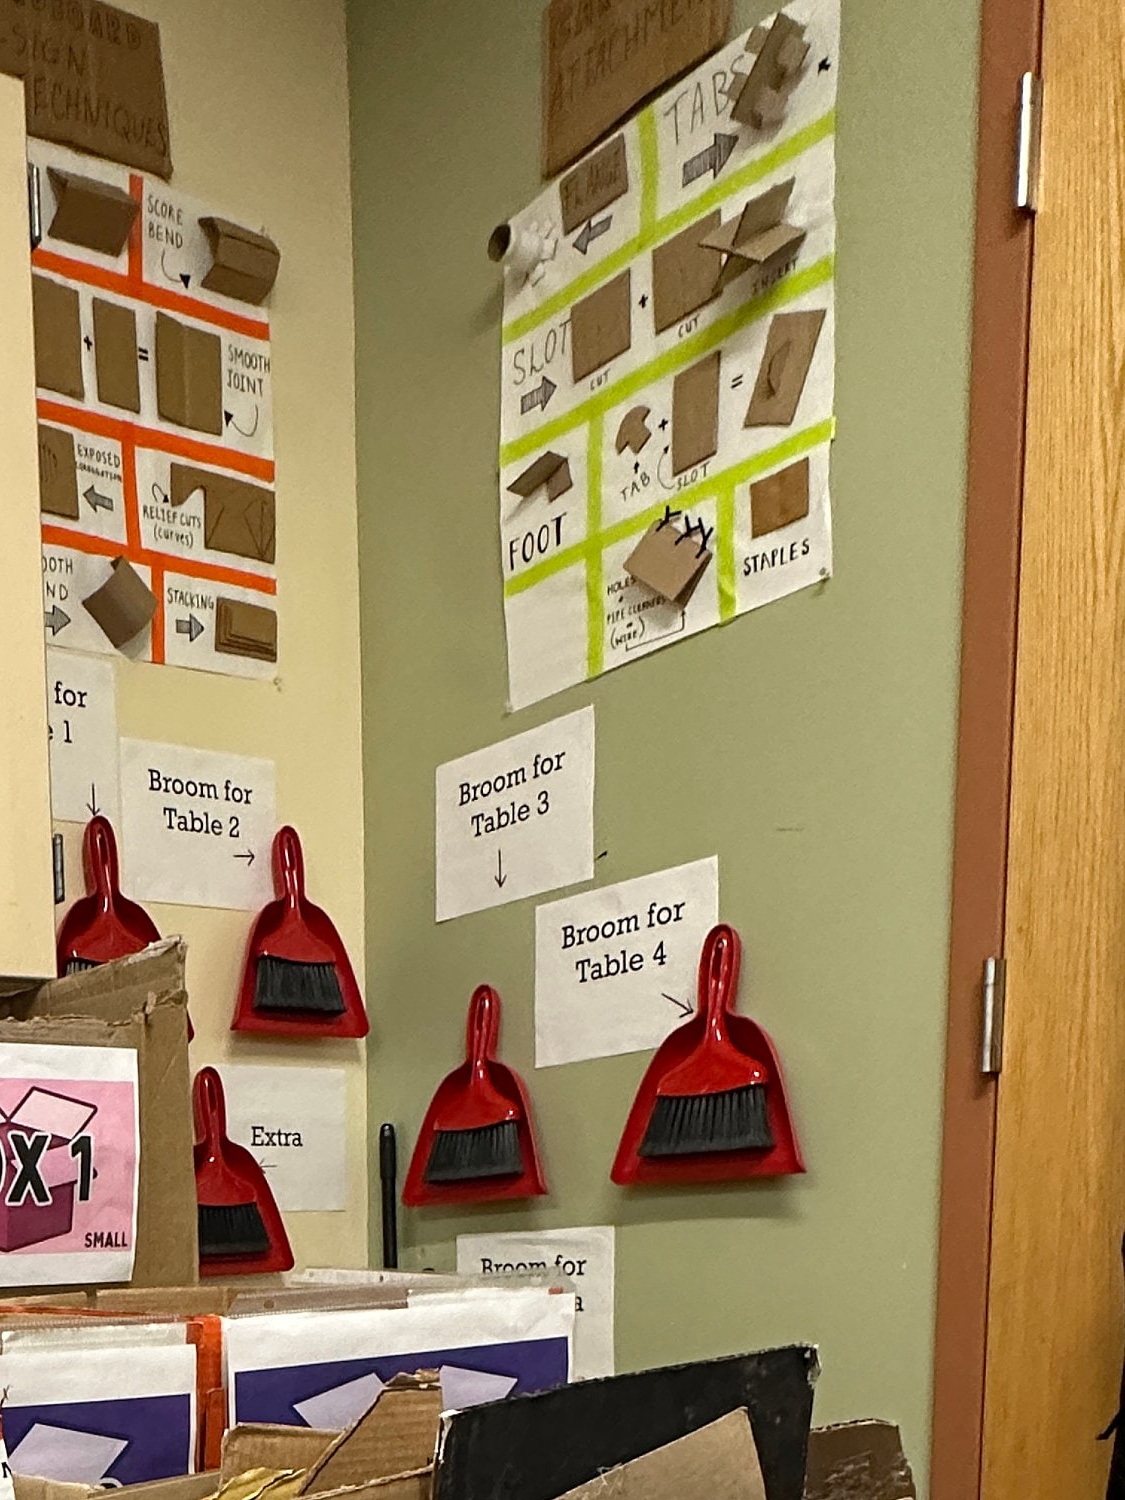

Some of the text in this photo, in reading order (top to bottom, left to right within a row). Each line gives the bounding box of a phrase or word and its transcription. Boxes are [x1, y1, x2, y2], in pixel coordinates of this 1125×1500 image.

[147, 194, 183, 227] SCORE
[148, 223, 183, 250] BEND
[677, 314, 700, 338] CUT
[228, 344, 271, 373] SMOOTH
[513, 319, 572, 386] SLOT
[227, 372, 264, 397] JOINT
[590, 369, 611, 391] CUT
[77, 444, 120, 468] EXPOSED
[619, 471, 650, 502] TAB
[675, 462, 710, 491] SLOT
[142, 505, 201, 528] RELIEF CUTS
[509, 512, 568, 571] FOOT
[743, 539, 811, 576] STAPLES
[167, 587, 214, 611] STACKING
[54, 681, 88, 708] for
[63, 720, 73, 744] 1
[148, 768, 253, 805] Broom for
[458, 751, 566, 807] Broom for
[163, 807, 240, 838] Table 2
[470, 790, 550, 837] Table 3
[561, 901, 686, 950] Broom for
[575, 940, 667, 984] Table 4
[250, 1126, 303, 1148] Extra
[71, 1135, 92, 1202] 1
[84, 1232, 128, 1249] SMALL
[554, 1254, 587, 1276] for
